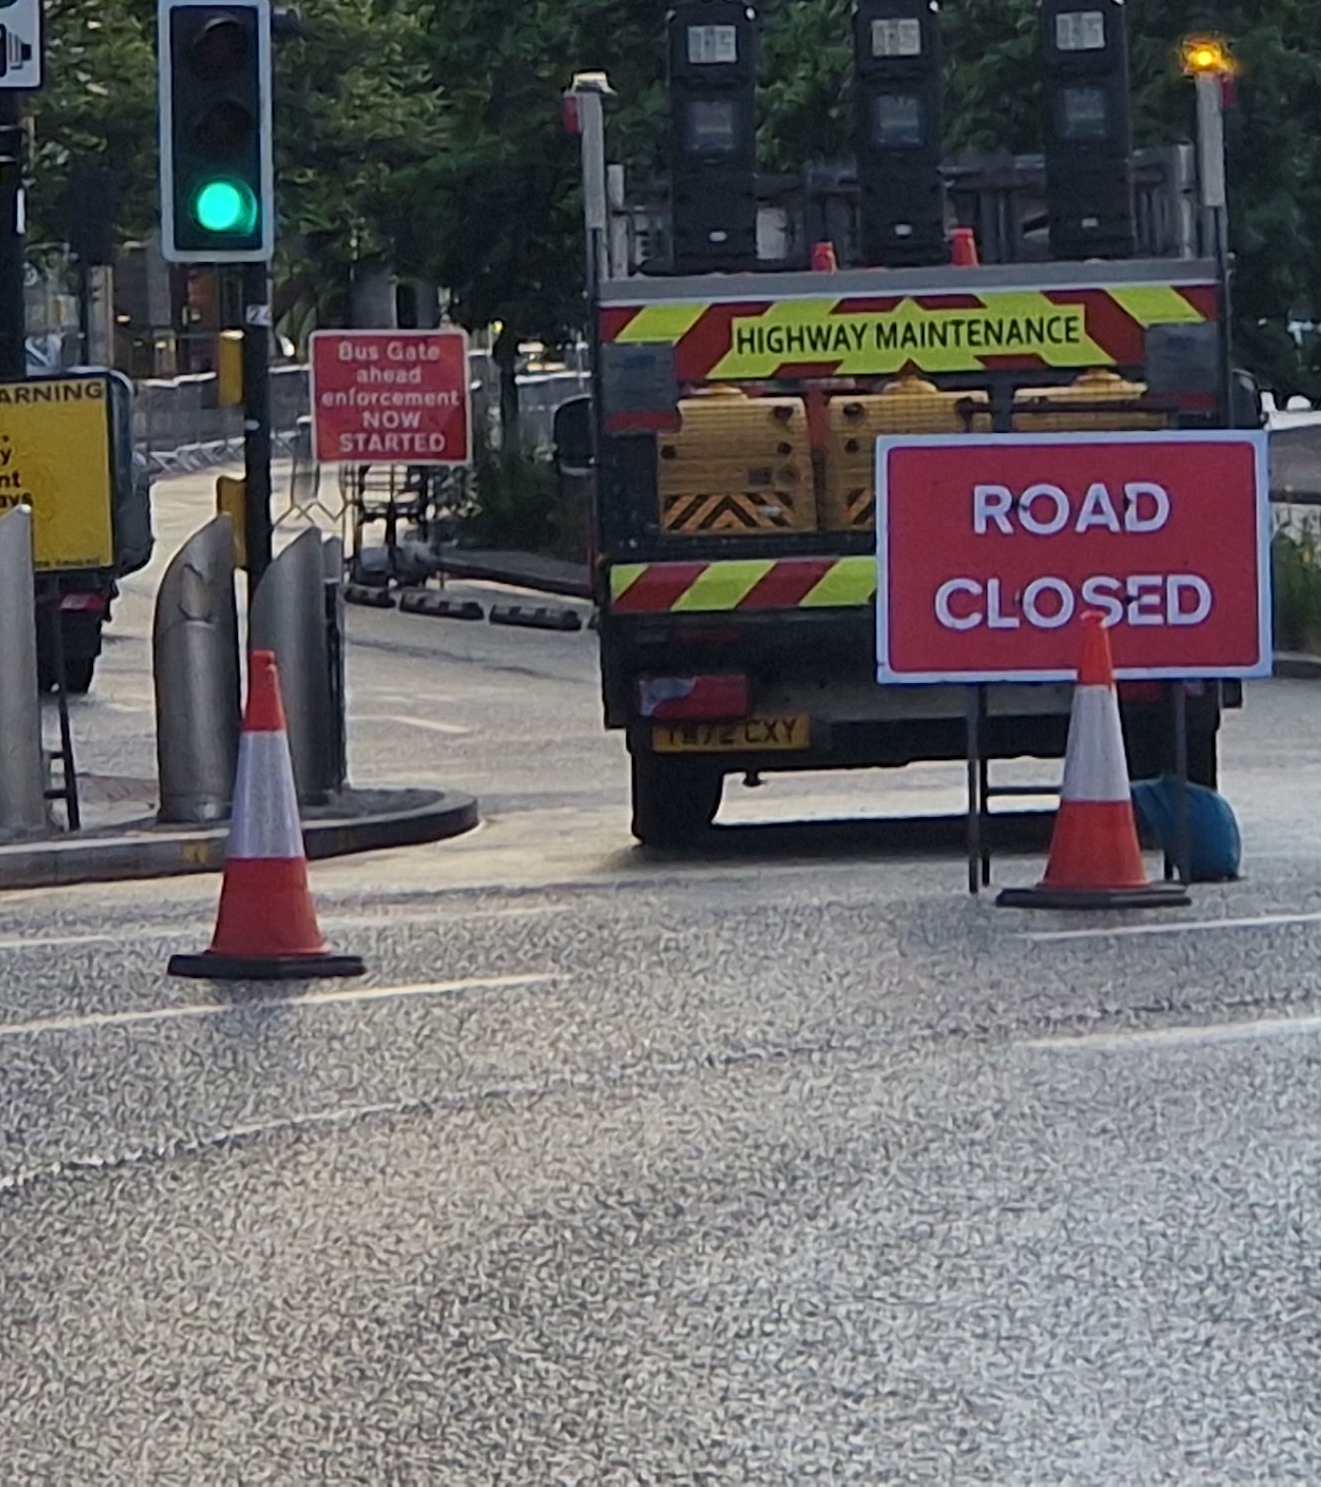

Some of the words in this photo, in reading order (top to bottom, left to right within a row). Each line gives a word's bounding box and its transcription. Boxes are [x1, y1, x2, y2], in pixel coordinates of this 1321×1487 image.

[736, 322, 868, 354] HIGHWAY
[876, 316, 1081, 350] MAINTENANCE
[339, 342, 379, 360] Bus
[387, 341, 441, 360] Gate
[356, 366, 422, 384] ahead
[321, 388, 461, 407] enforcement
[362, 411, 422, 429] NOW
[339, 433, 446, 452] STARTED
[973, 482, 1170, 535] ROAD
[934, 575, 1212, 631] CLOSED
[744, 718, 797, 743] CXY
